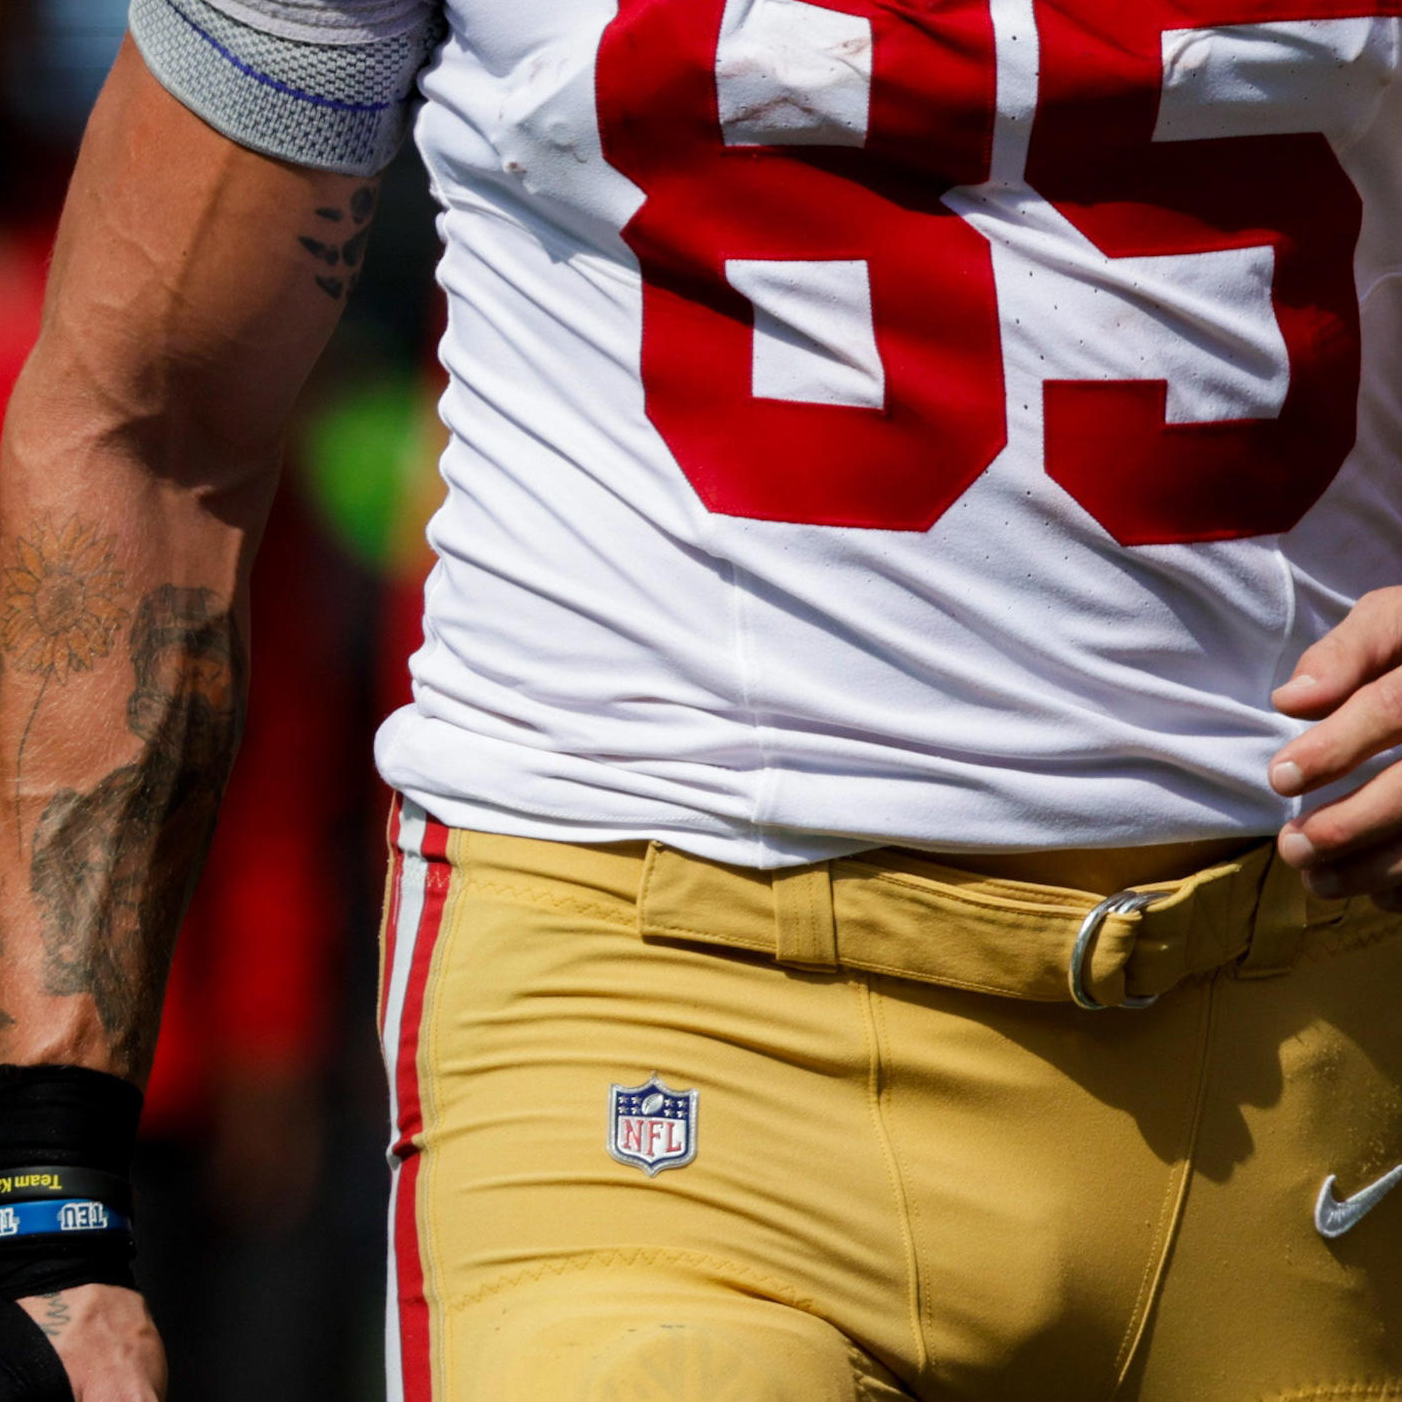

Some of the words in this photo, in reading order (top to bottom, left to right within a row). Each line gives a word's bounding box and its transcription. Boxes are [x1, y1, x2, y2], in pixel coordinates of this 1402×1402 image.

[622, 1118, 681, 1157] NFL
[15, 1173, 62, 1191] Team
[62, 1204, 105, 1229] TEU
